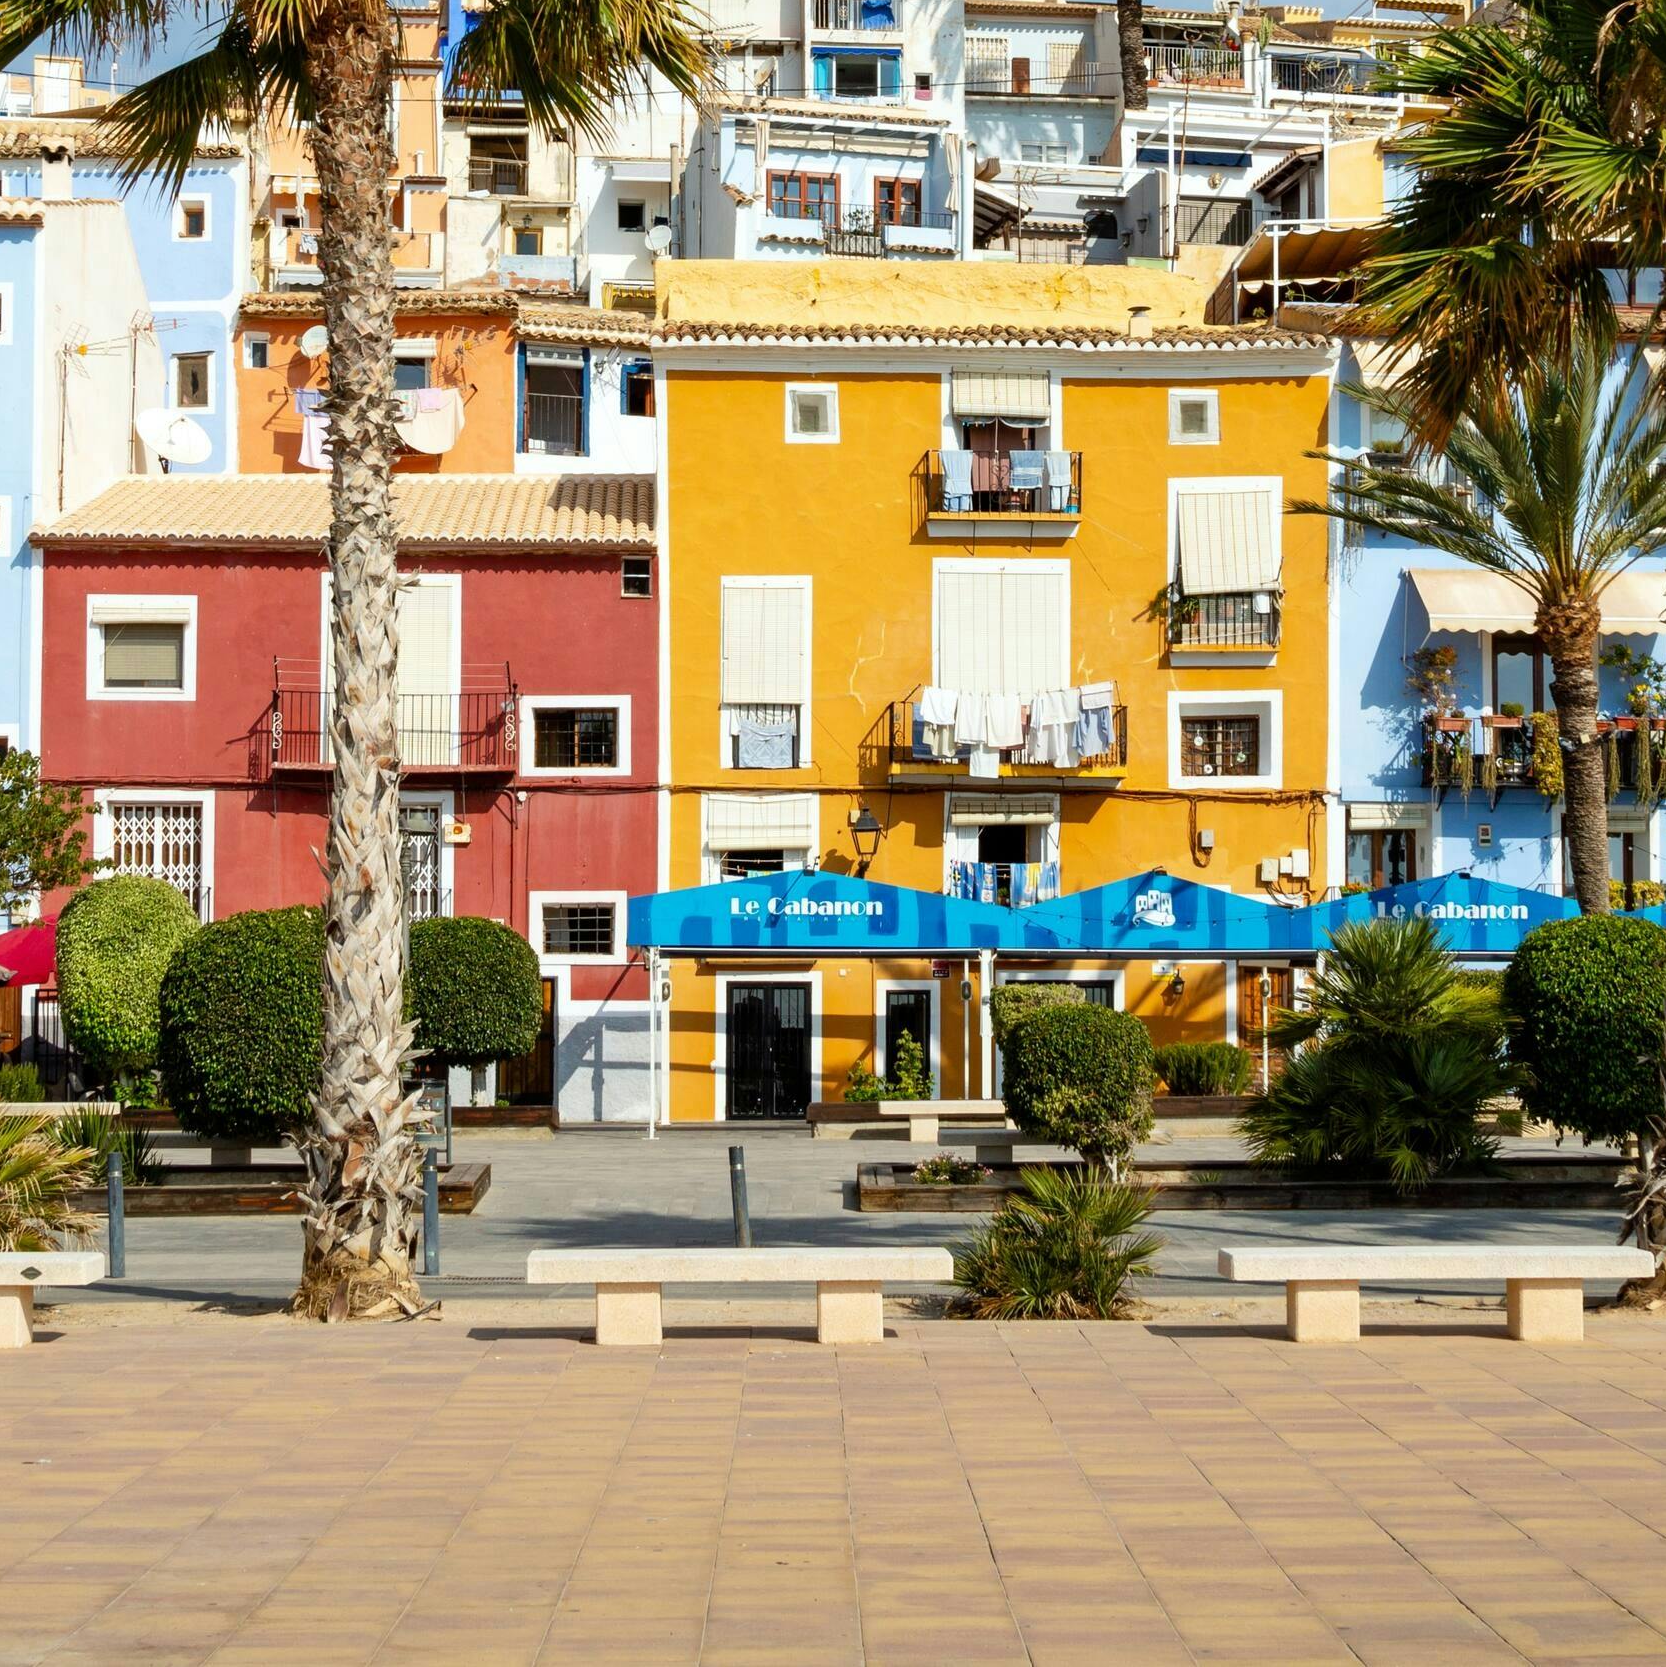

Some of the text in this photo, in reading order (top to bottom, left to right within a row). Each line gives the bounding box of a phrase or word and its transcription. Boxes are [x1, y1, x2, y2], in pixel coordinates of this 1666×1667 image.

[731, 897, 883, 916] Le Cabanon
[1414, 901, 1529, 920] Cabanon
